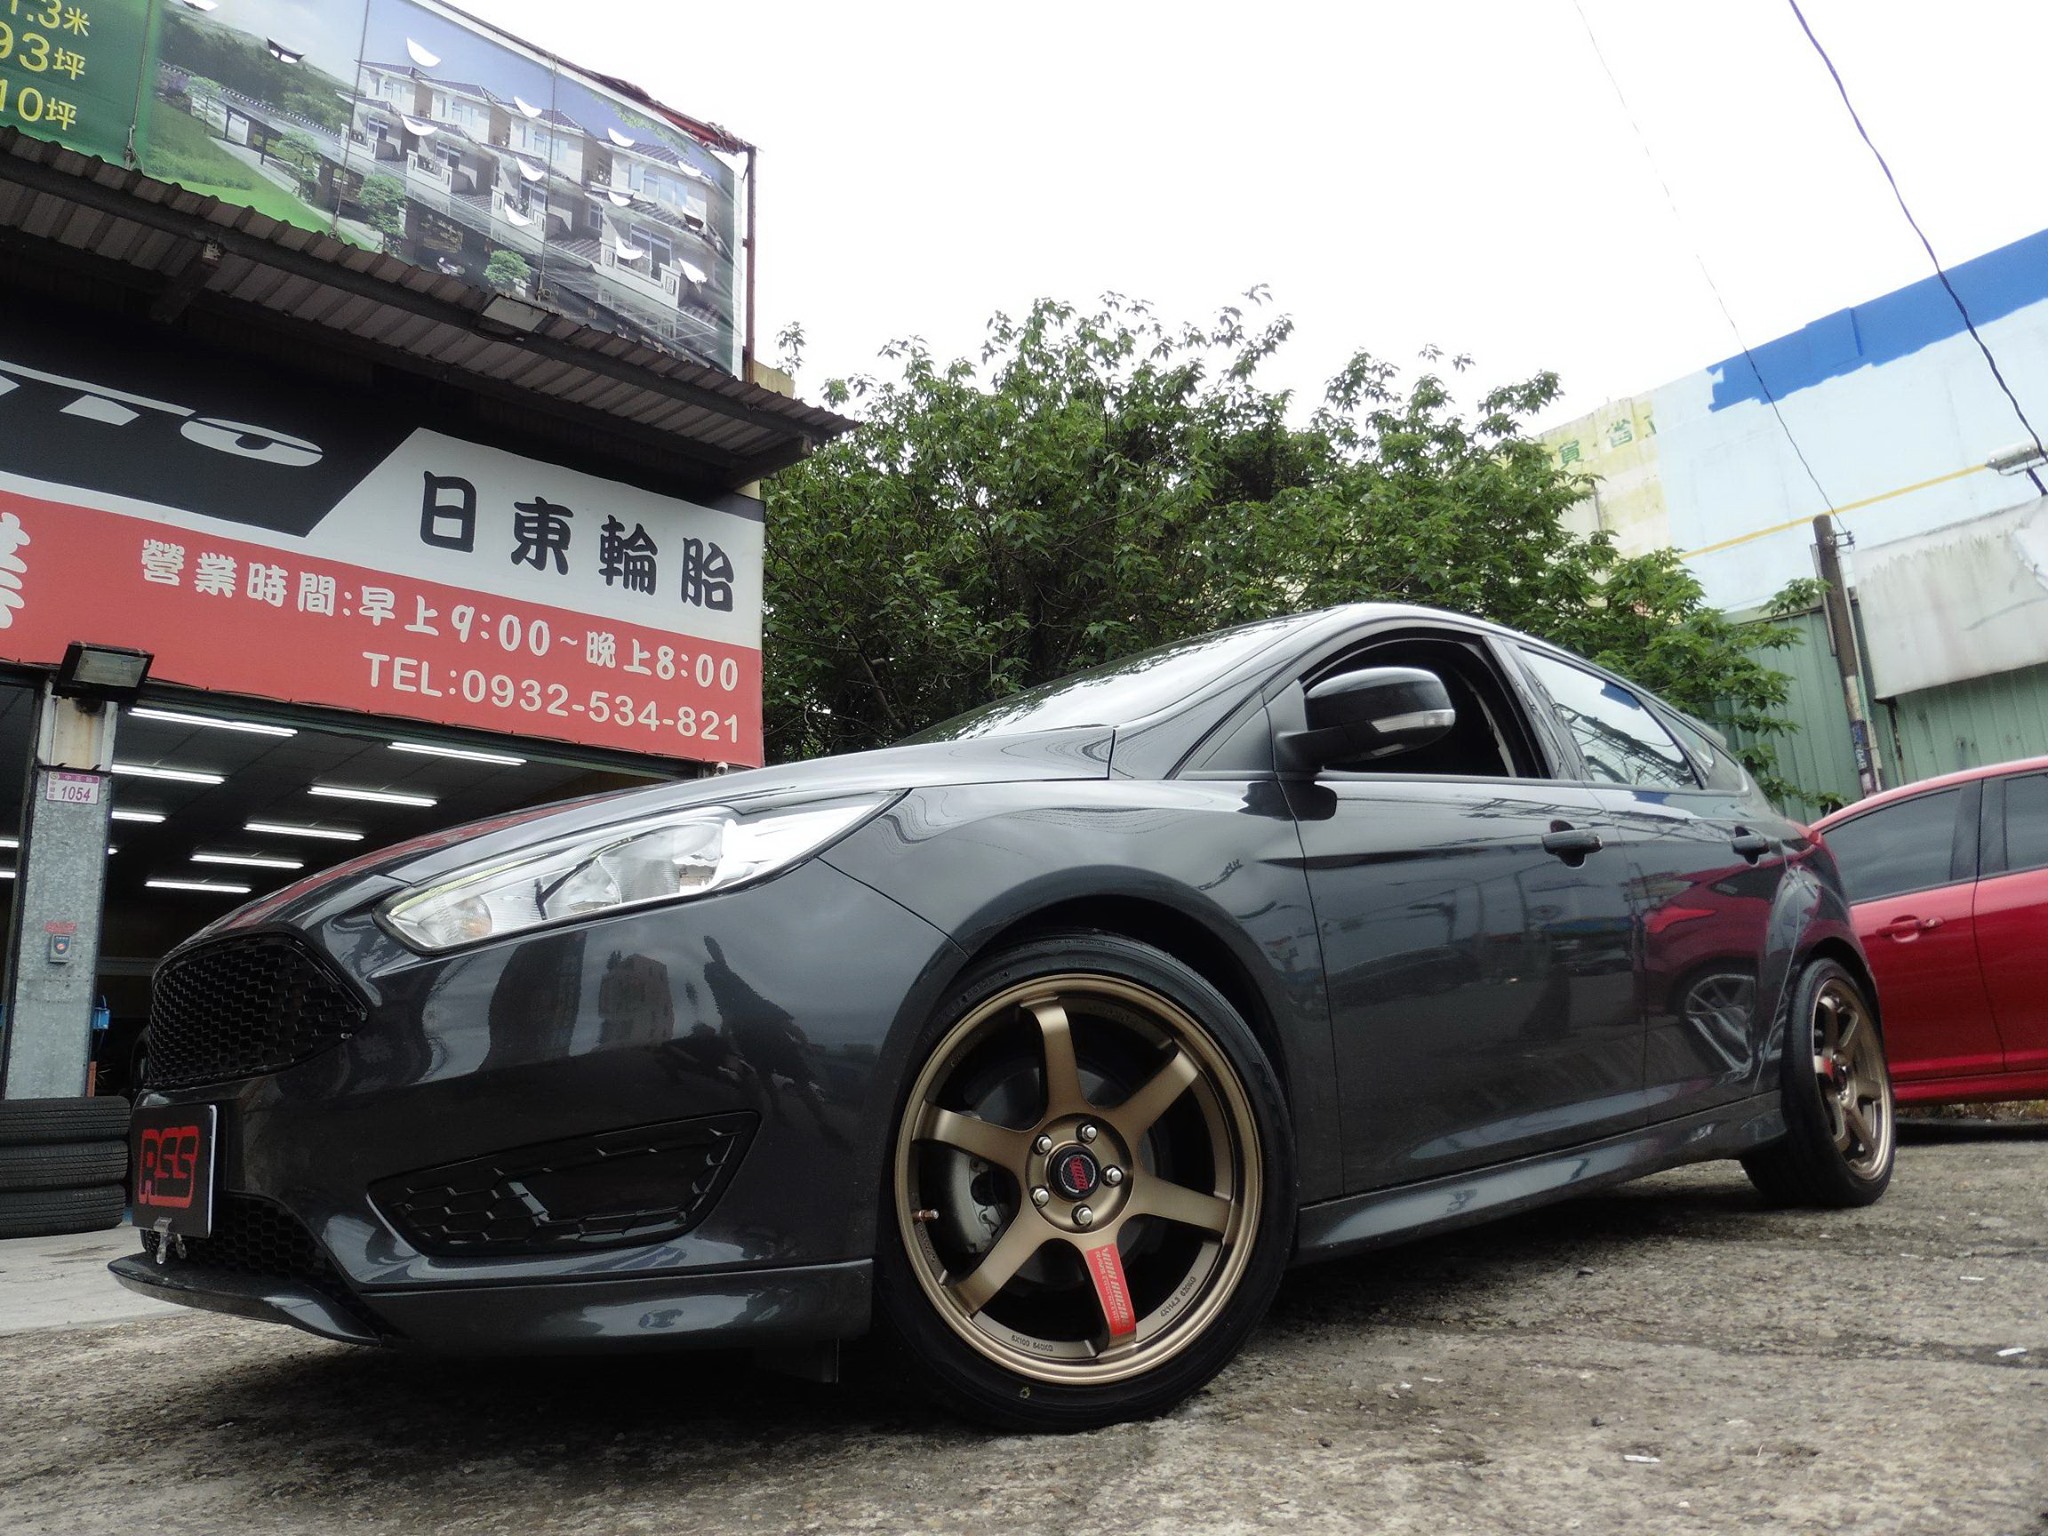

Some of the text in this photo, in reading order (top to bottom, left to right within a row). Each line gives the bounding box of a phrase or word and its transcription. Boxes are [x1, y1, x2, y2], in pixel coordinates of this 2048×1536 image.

[420, 470, 734, 612] 日東輪胎
[362, 651, 738, 743] TEL:0932-534-821
[62, 786, 91, 801] 1054
